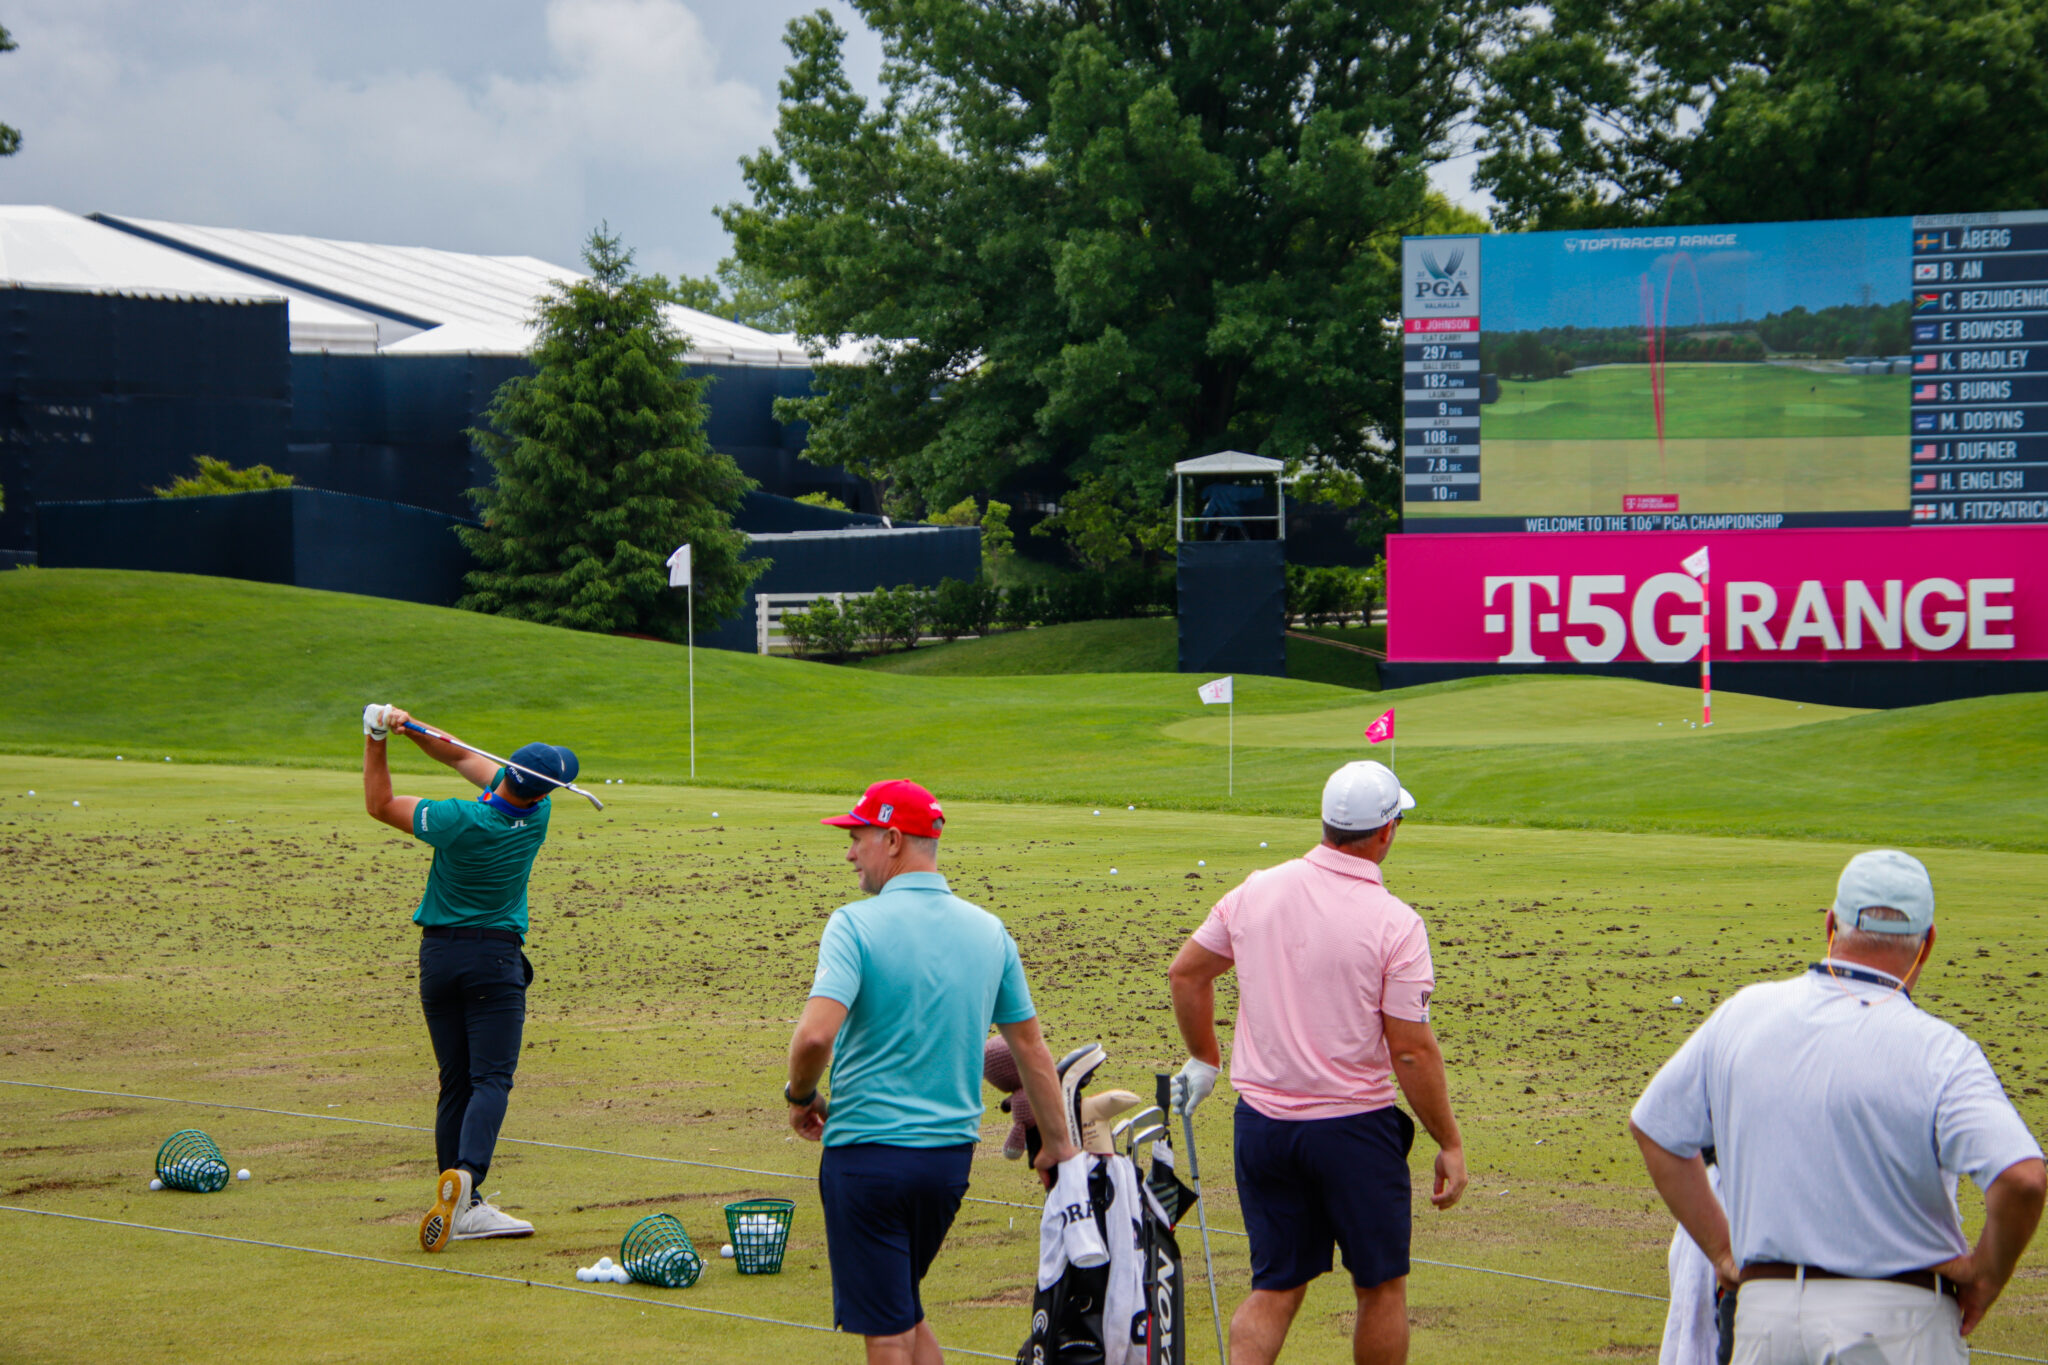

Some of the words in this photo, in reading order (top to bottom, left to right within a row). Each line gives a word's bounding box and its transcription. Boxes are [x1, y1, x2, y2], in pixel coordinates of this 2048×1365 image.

[1579, 236, 1676, 250] TOPTRACER
[1679, 234, 1737, 246] RANGE
[1943, 231, 1957, 249] L.
[1960, 225, 2011, 248] ÅBERG
[1943, 261, 1957, 279] B.
[1961, 260, 1983, 279] AN
[1415, 281, 1469, 297] PGA
[1942, 292, 1957, 309] C.
[1427, 319, 1470, 330] JOHNSON
[1942, 322, 1956, 339] E.
[1960, 320, 2024, 339] BOWSER
[1423, 345, 1447, 359] 297
[1942, 352, 1956, 369] K.
[1960, 350, 2029, 369] BRADLEY
[1424, 374, 1447, 388] 182
[1449, 379, 1464, 387] MPH
[1942, 382, 1956, 400] S.
[1960, 381, 2011, 399] BURNS
[1439, 402, 1447, 415] 9
[1449, 407, 1462, 415] DEG
[1941, 412, 1958, 430] M.
[1963, 411, 2024, 430] DOBYNS
[1424, 430, 1447, 444] 108
[1941, 443, 1953, 460] J.
[1958, 441, 2017, 460] DUFNER
[1427, 458, 1447, 472] 7.8
[1449, 464, 1462, 472] SEC
[1941, 472, 1956, 490] H.
[1960, 471, 2024, 490] ENGLISH
[1433, 486, 1448, 500] 10
[1941, 502, 1958, 520] M.
[1526, 517, 1585, 532] WELCOME
[1587, 517, 1603, 531] TO
[1604, 516, 1628, 531] THE
[1664, 516, 1689, 530] PGA
[1690, 514, 1783, 530] CHAMPIONSHIP
[1725, 578, 2015, 652] RANGE
[425, 1215, 444, 1246] GOLF
